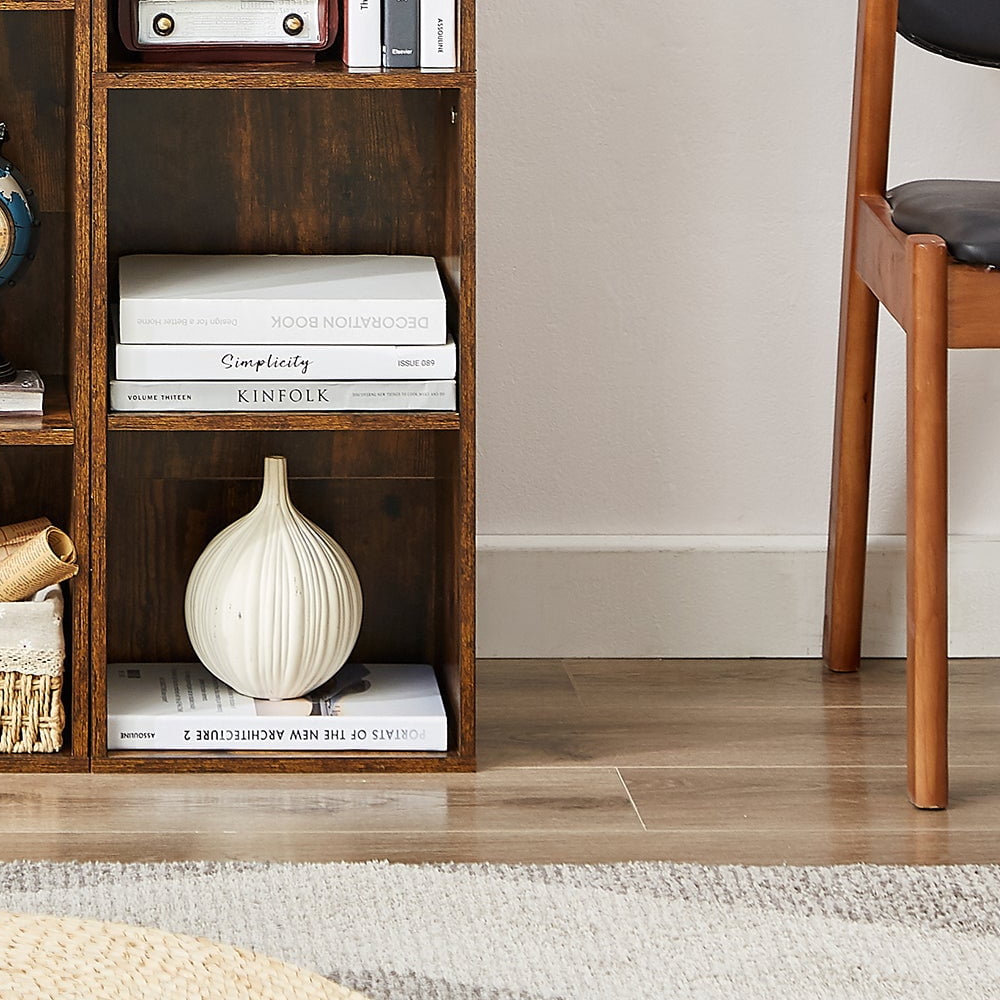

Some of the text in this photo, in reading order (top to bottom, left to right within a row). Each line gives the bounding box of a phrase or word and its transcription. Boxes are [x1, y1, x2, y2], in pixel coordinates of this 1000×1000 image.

[437, 18, 445, 53] ASSOULINE
[137, 318, 162, 327] Home
[164, 318, 188, 327] Better
[197, 318, 208, 327] for
[210, 318, 238, 327] Design
[271, 315, 429, 330] DECORATION BOOK
[221, 353, 314, 374] Simplicity
[398, 359, 436, 368] ISSUE 089
[161, 393, 192, 401] THITEEN
[237, 389, 330, 403] KINFOLK
[183, 728, 428, 741] PORTATS OF THE NEW ARCHITECTURE 2
